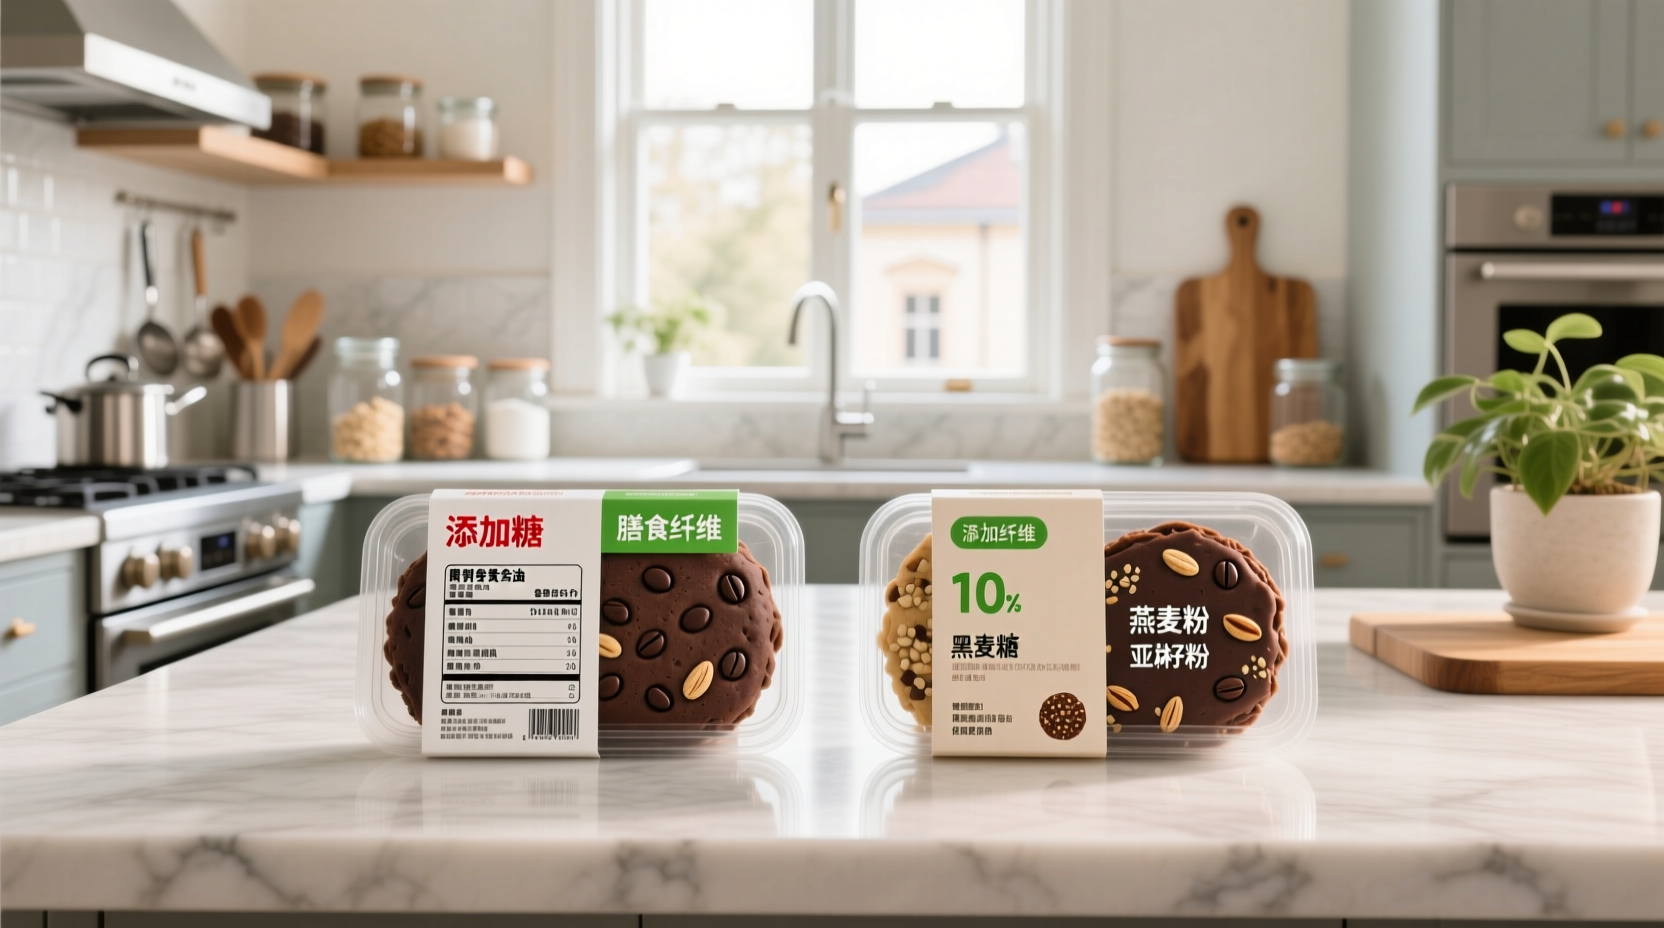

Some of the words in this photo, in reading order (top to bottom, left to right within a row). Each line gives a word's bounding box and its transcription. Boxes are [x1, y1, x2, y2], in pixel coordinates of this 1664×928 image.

[445, 514, 544, 549] 添加糖
[616, 513, 723, 543] 膳食纤维
[952, 571, 1022, 615] 10%
[1129, 604, 1210, 635] 燕麦粉
